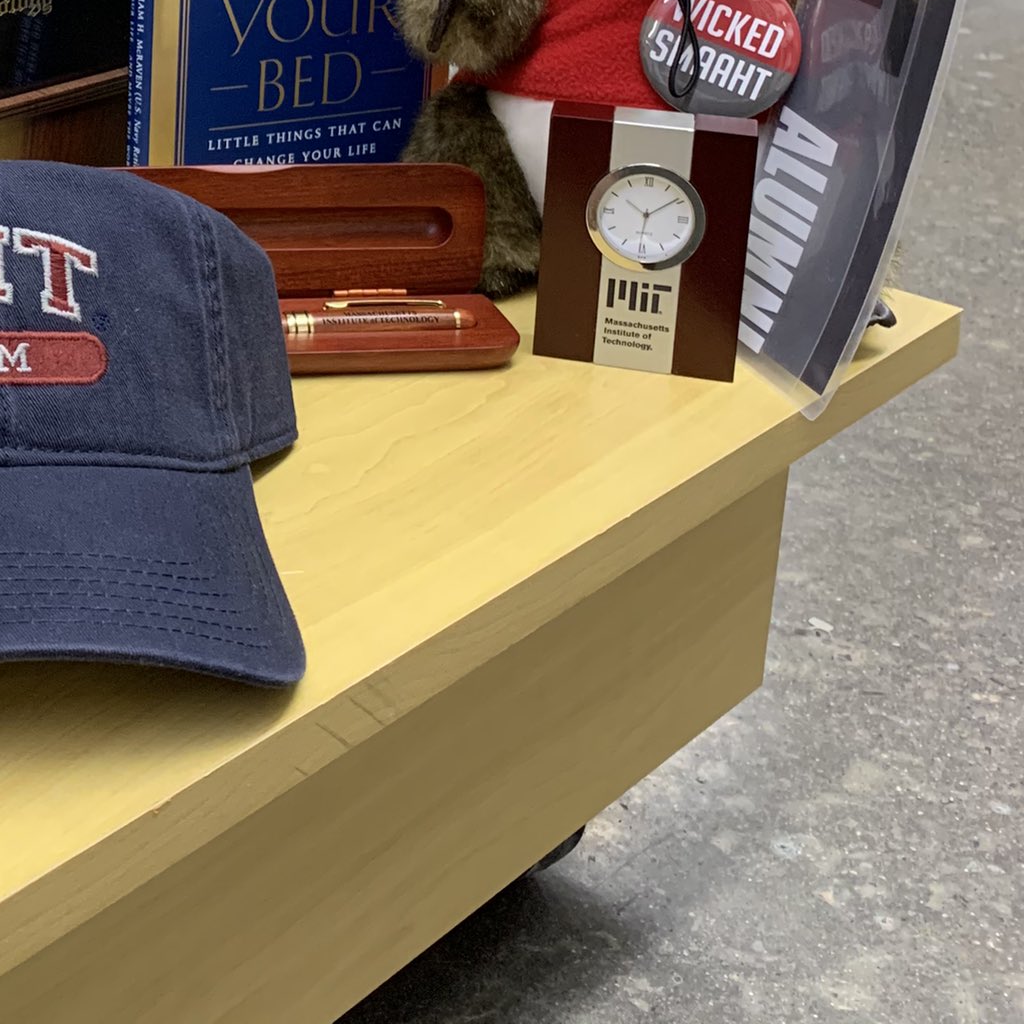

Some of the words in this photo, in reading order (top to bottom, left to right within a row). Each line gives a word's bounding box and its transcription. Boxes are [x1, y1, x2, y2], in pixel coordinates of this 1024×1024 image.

[135, 39, 144, 89] McRAVEN
[258, 51, 362, 112] BED
[208, 135, 259, 151] LITTLE
[266, 128, 321, 144] THINGS
[328, 122, 366, 137] THAT
[373, 118, 402, 131] CAN
[302, 147, 341, 162] YOUR
[348, 143, 376, 156] LIFE
[737, 105, 839, 354] ALUMNI
[322, 317, 369, 325] INSTITUTE
[605, 317, 670, 332] Massachusetts
[604, 327, 640, 339] Institute
[602, 336, 653, 351] Technology.
